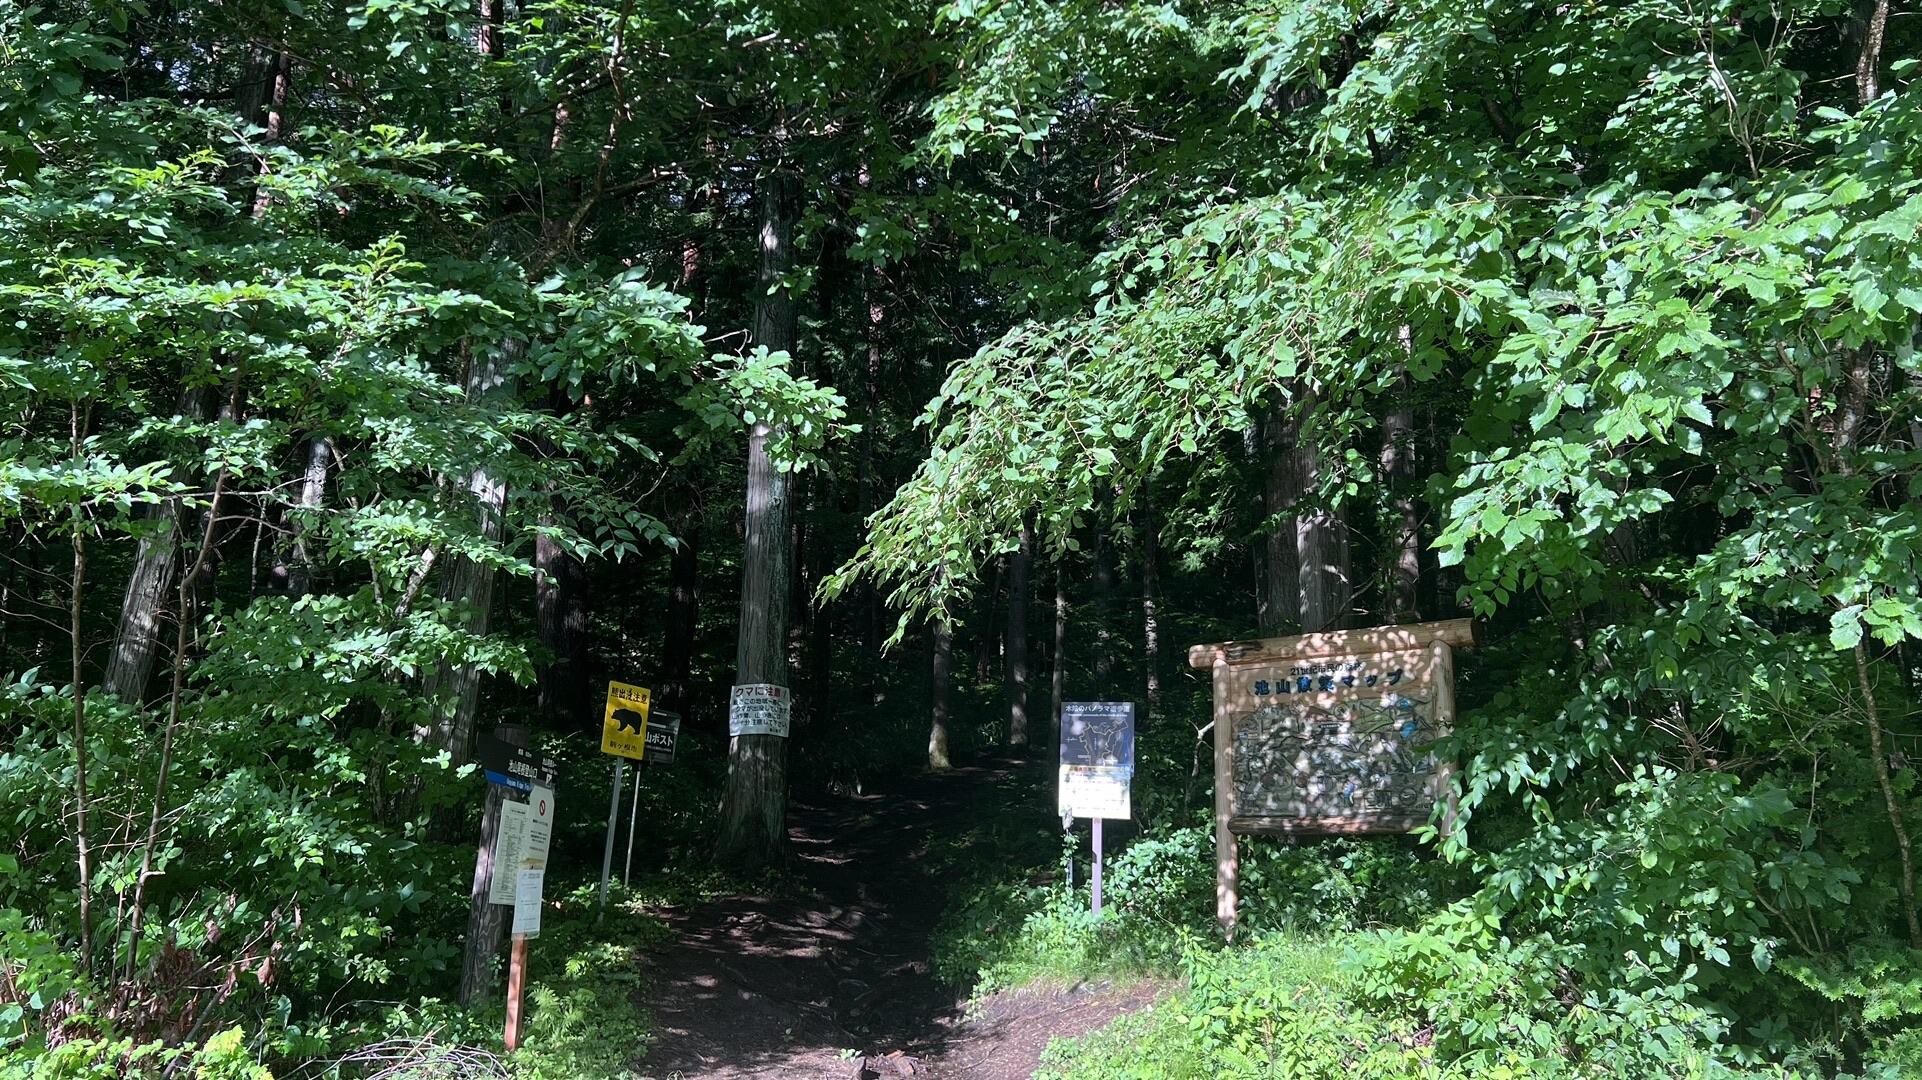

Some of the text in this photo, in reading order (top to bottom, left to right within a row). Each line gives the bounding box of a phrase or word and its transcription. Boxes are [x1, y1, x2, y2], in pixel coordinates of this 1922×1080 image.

[1254, 669, 1403, 696] 池山散策マップ
[611, 686, 648, 704] 熊出没注意
